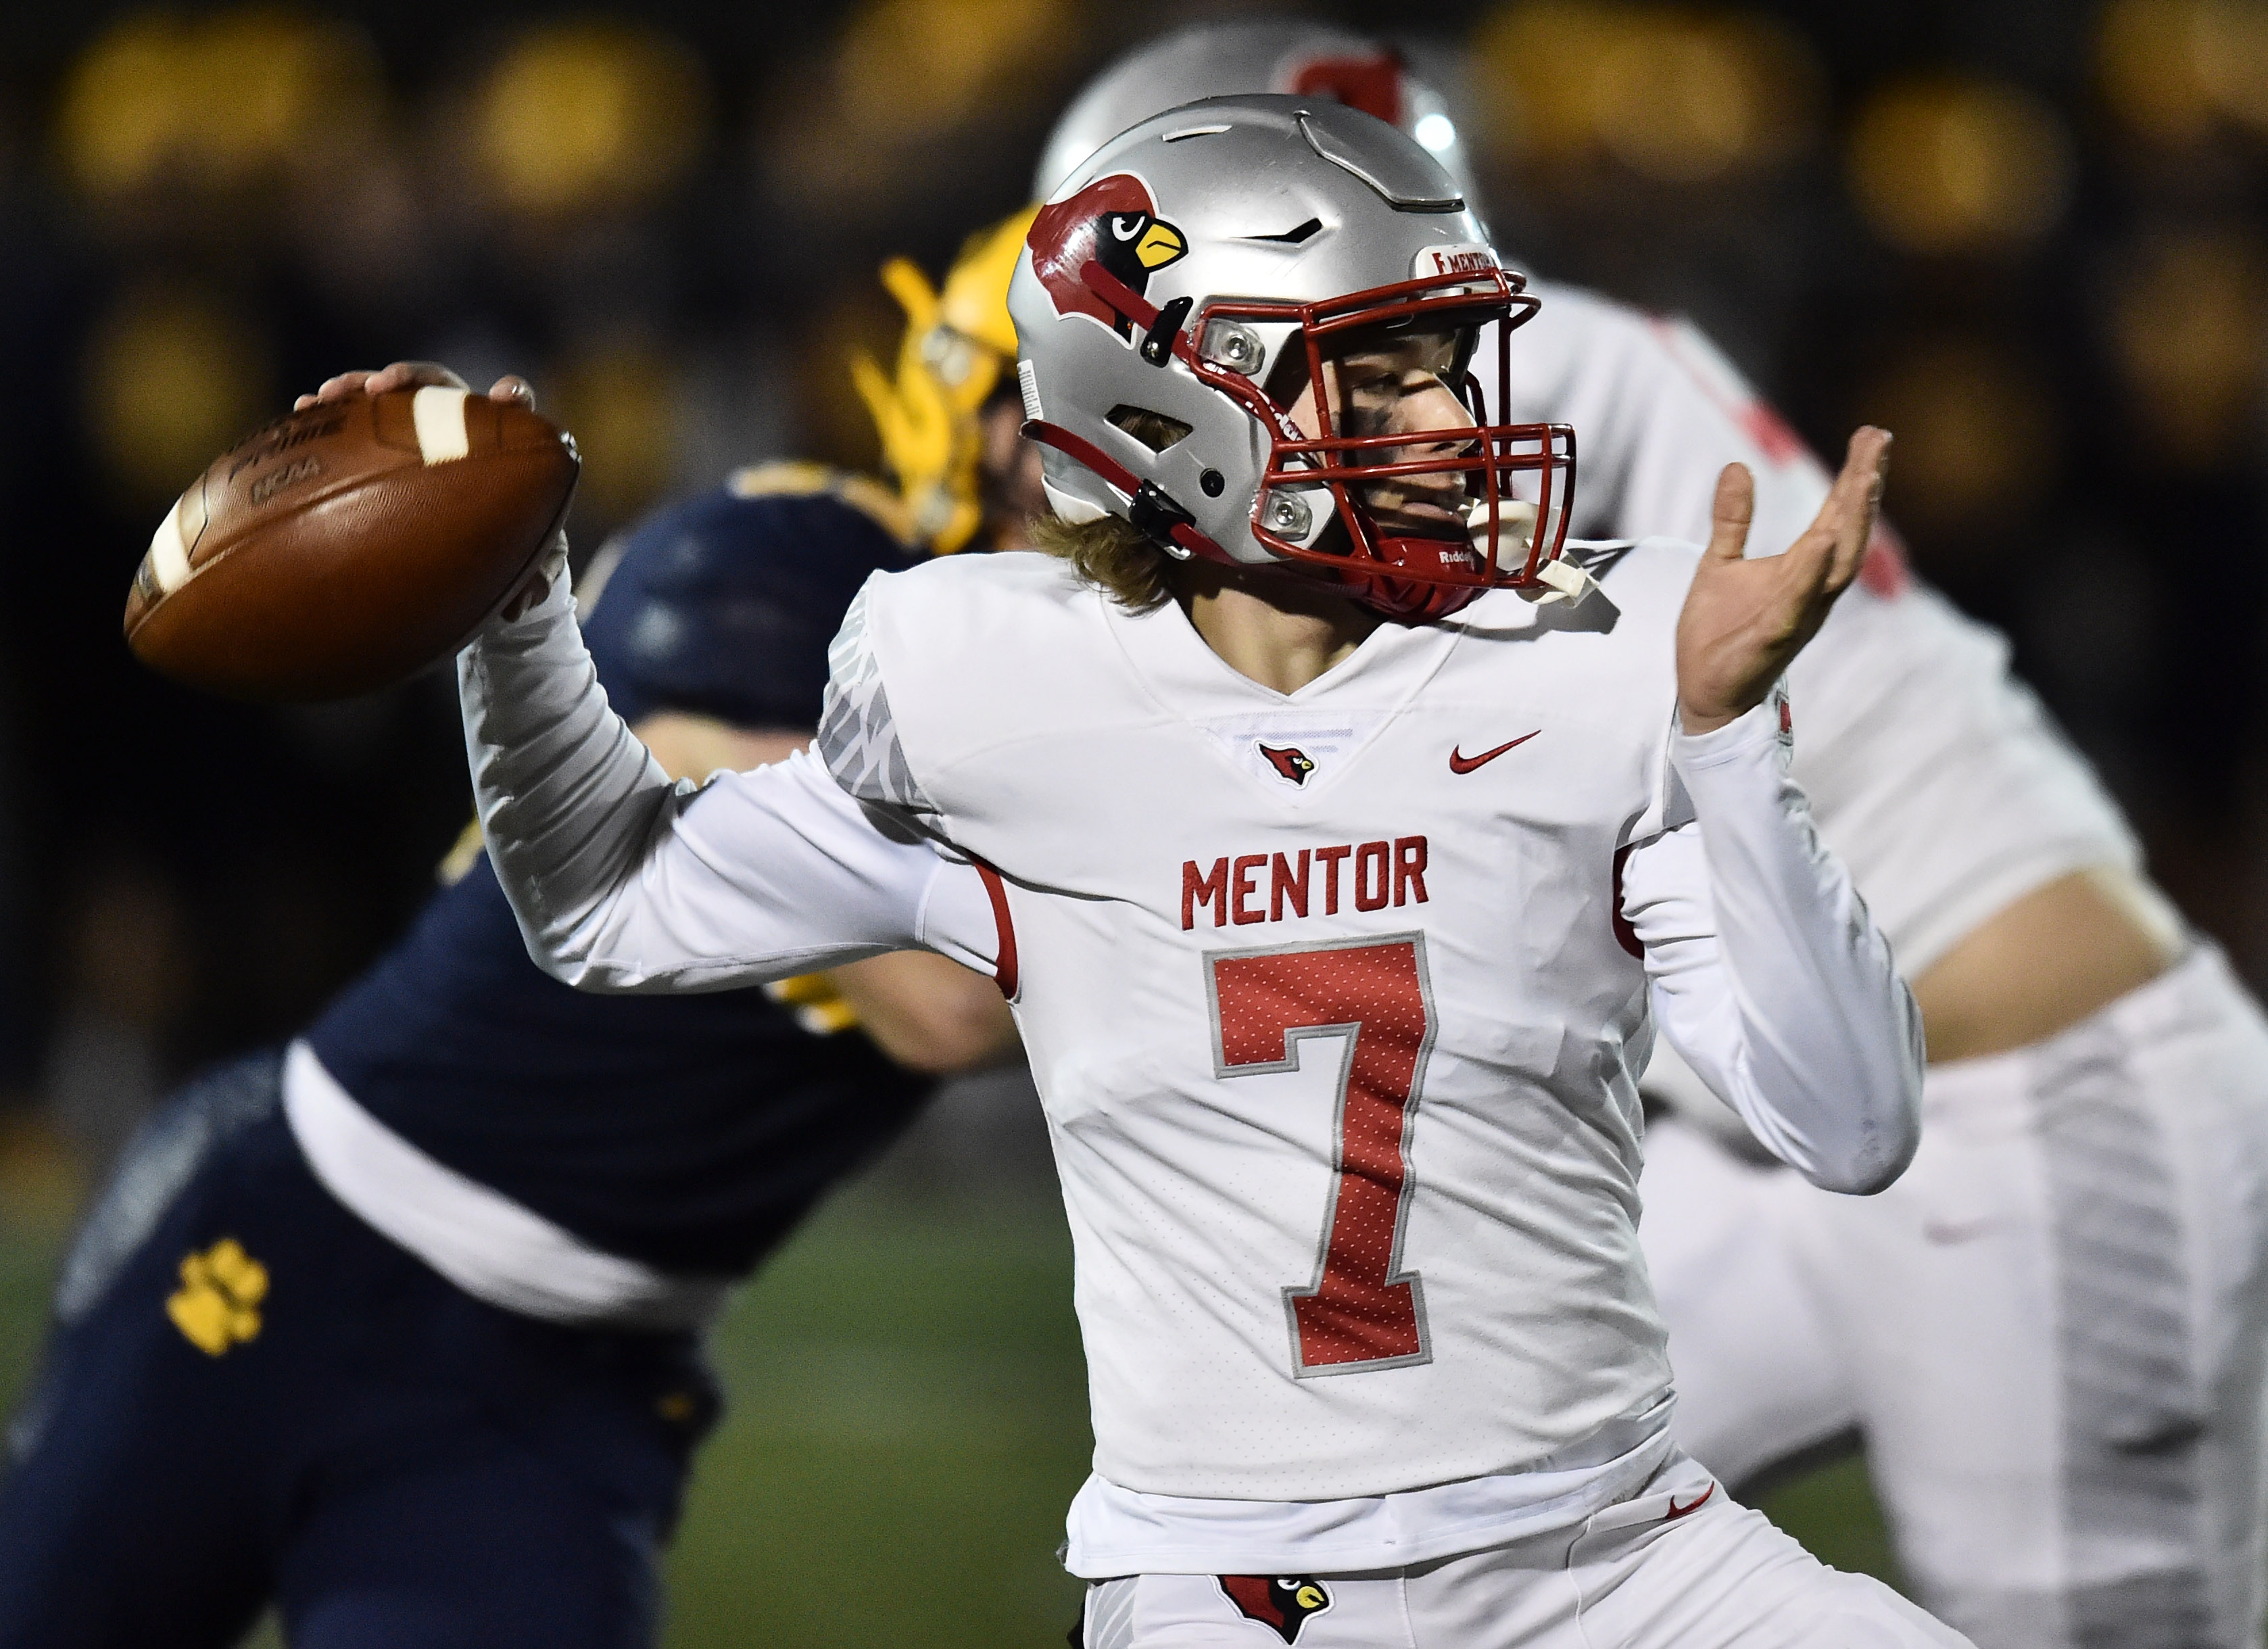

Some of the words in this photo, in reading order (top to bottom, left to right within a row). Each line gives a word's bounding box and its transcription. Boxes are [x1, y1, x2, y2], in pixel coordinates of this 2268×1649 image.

[1447, 252, 1496, 273] MENTO
[1181, 835, 1429, 931] MENTOR
[1202, 929, 1439, 1379] 7
